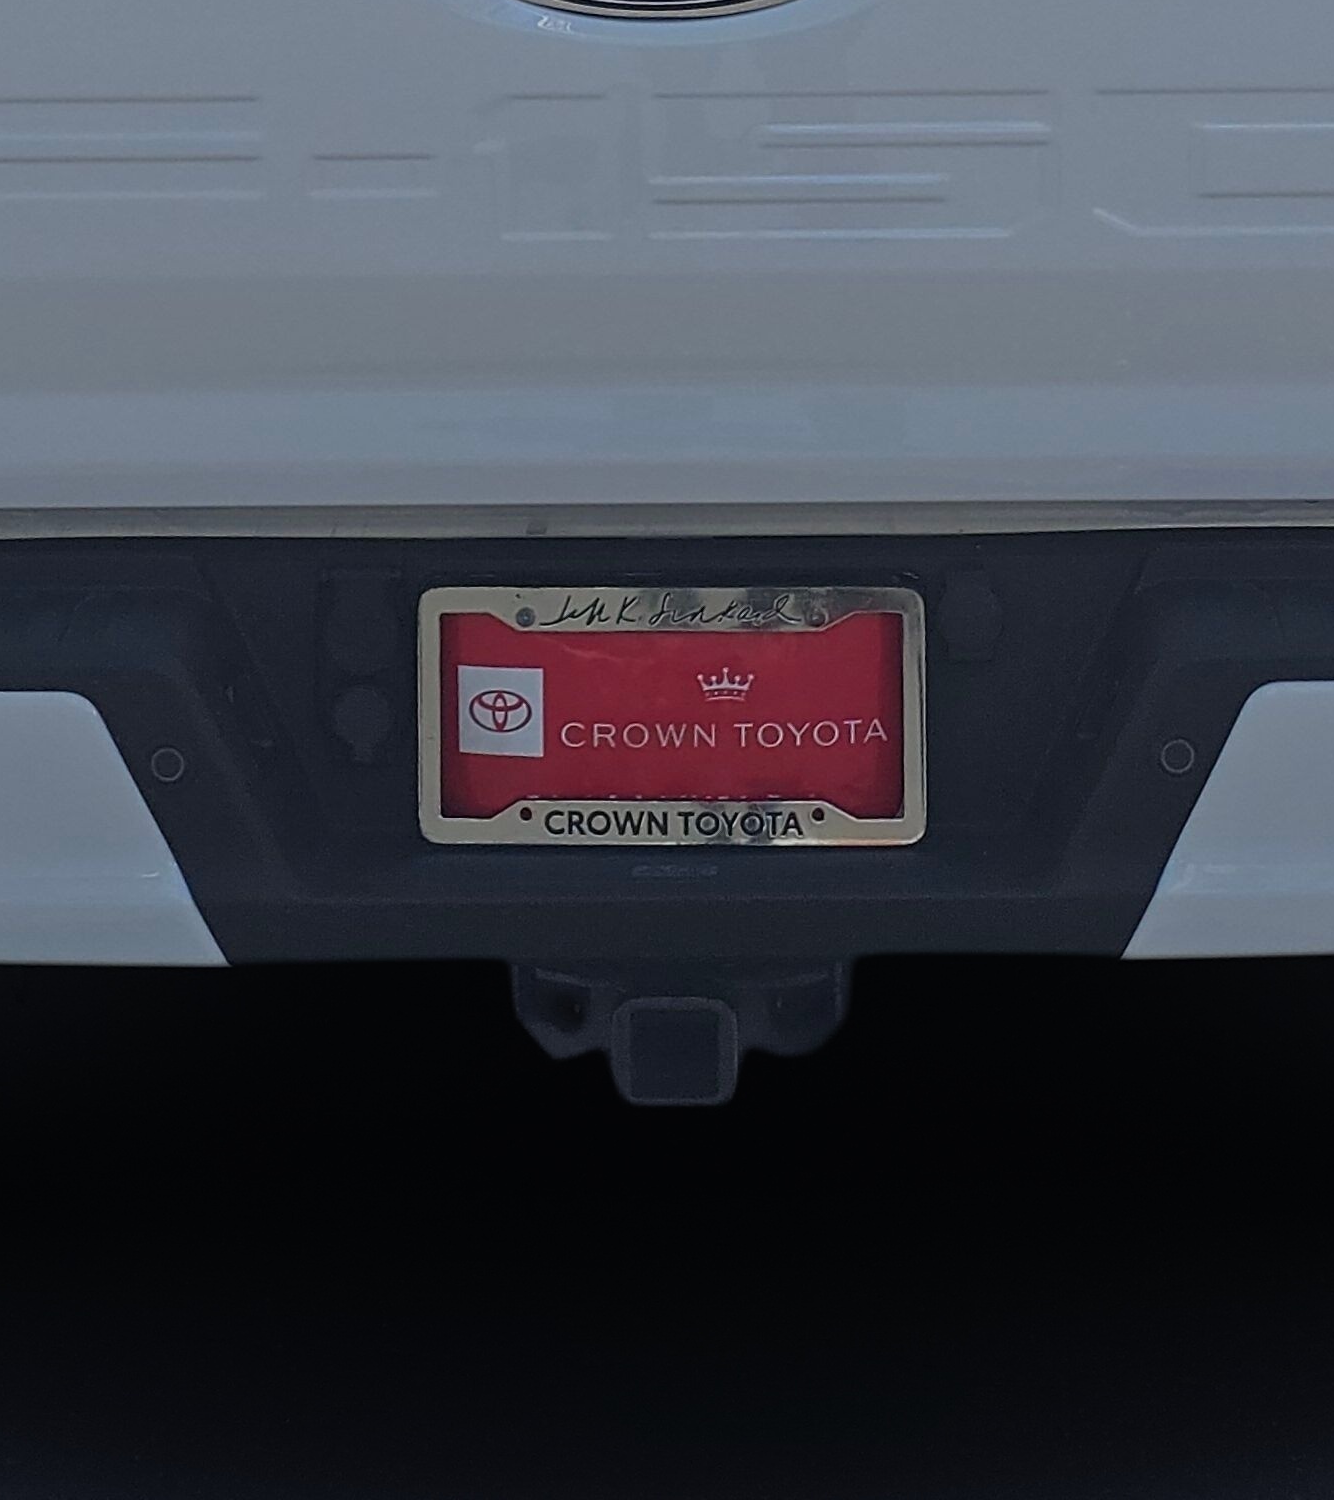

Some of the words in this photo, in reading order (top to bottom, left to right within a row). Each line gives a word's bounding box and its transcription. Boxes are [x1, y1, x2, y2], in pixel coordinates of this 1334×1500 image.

[560, 722, 717, 749] CROWN
[733, 717, 889, 749] TOYOTA
[543, 809, 669, 837] CROWN
[676, 809, 805, 838] TOYOTA
